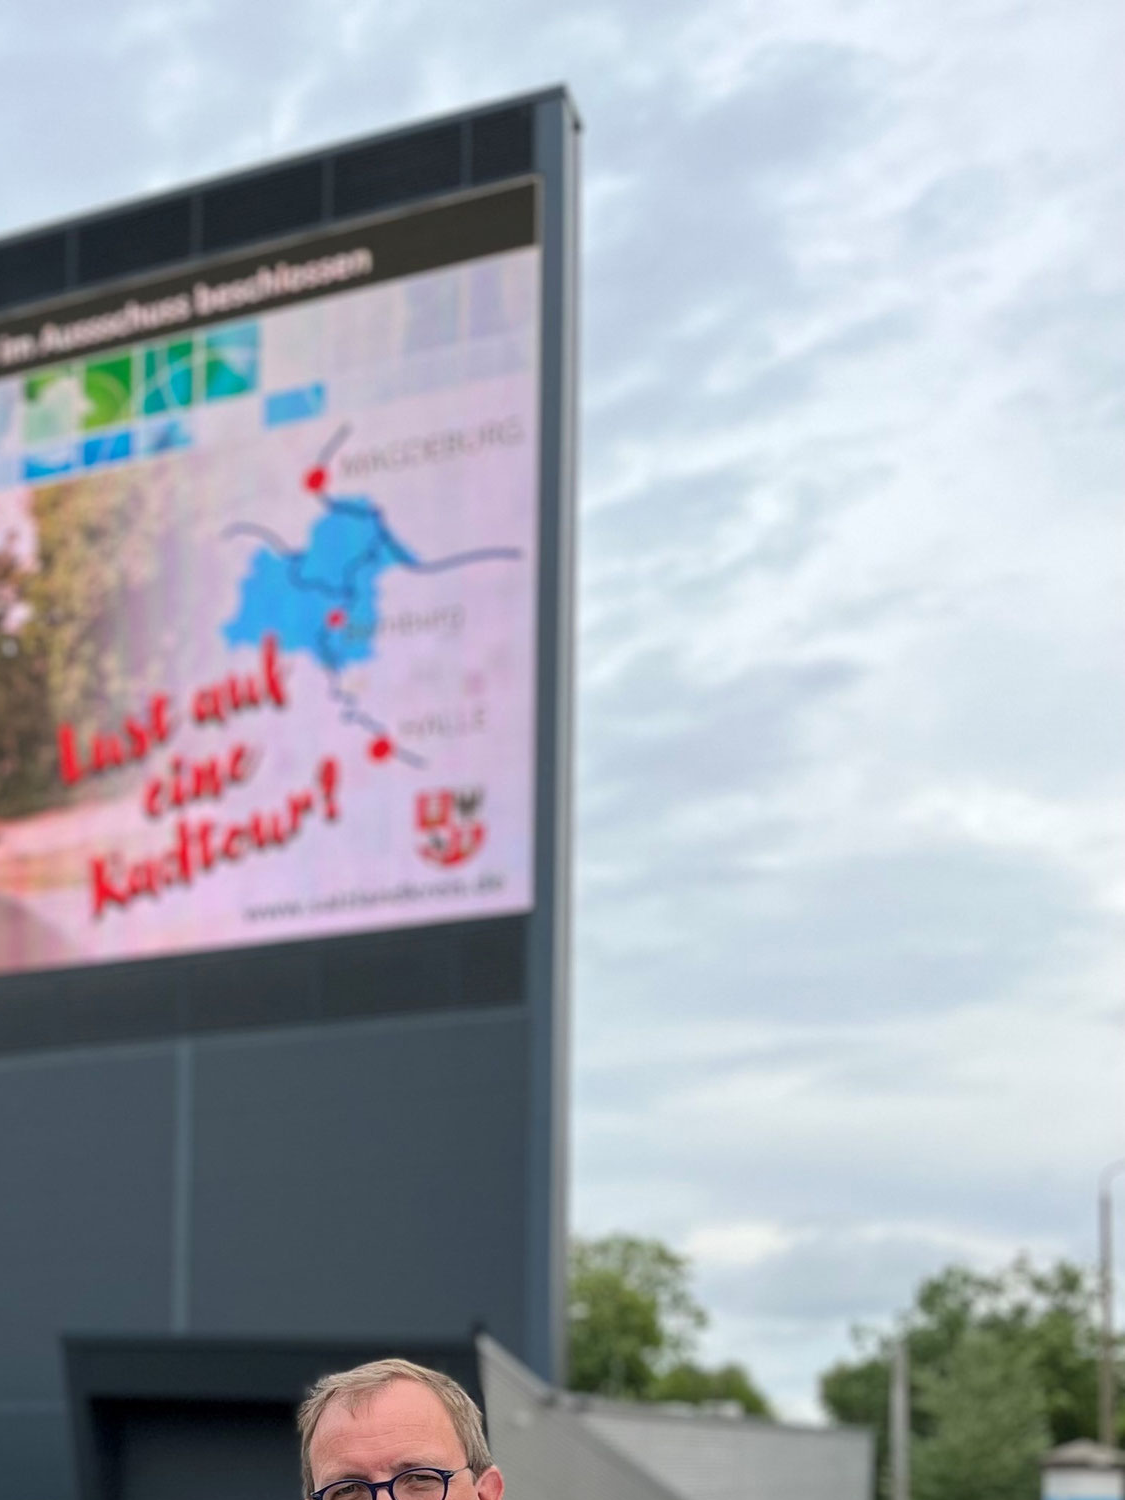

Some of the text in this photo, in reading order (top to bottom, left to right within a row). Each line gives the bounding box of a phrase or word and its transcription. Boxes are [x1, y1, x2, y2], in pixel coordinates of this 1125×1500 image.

[194, 246, 373, 315] beschlossen
[56, 633, 289, 787] Lust auf
[143, 742, 252, 819] eine
